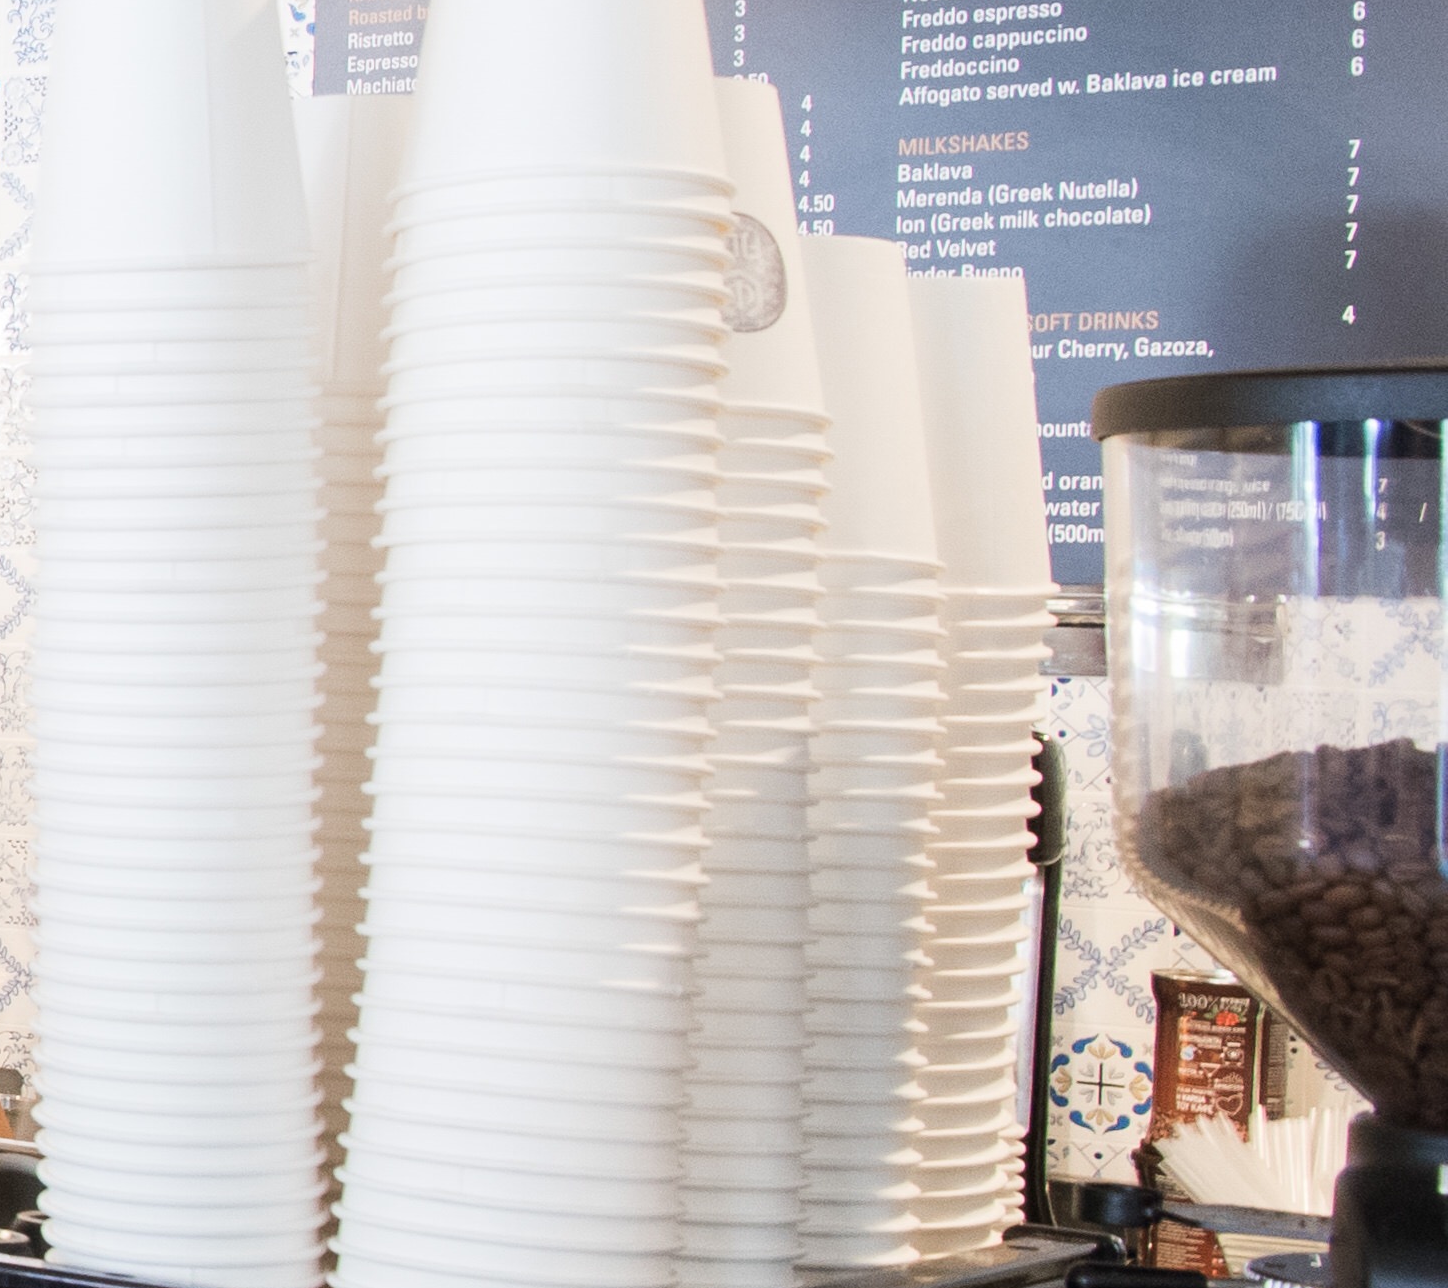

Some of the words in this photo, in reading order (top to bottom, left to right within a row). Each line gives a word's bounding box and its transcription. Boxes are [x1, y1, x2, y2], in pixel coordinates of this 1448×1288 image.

[348, 6, 412, 28] Roasted
[734, 0, 747, 17] 3
[902, 6, 969, 29] Freddo
[972, 1, 1063, 26] espresso
[1352, 0, 1366, 21] 6
[347, 30, 414, 50] Ristretto
[733, 24, 746, 42] 3
[901, 32, 968, 55] Freddo
[971, 23, 1088, 51] cappuccino
[1351, 28, 1365, 49] 6
[347, 53, 419, 75] Espresso
[732, 48, 745, 67] 3
[900, 55, 1020, 80] Freddoccino
[1350, 56, 1364, 77] 6
[899, 85, 981, 107] Affogato
[986, 77, 1053, 100] served
[1057, 78, 1080, 96] w.
[1085, 72, 1167, 94] Baklava
[1172, 67, 1204, 88] ice
[1209, 64, 1277, 86] cream
[801, 94, 813, 112] 4
[800, 119, 812, 137] 4
[799, 144, 811, 162] 4
[897, 131, 1030, 157] MILKSHAKES
[1348, 138, 1361, 159] 7
[798, 169, 810, 187] 4
[896, 164, 973, 183] Baklava
[1347, 166, 1360, 187] 7
[798, 194, 835, 213] 4.50
[896, 185, 983, 209] Merenda
[987, 181, 1054, 207] (Greek
[1058, 177, 1139, 201] Nutella)
[1346, 194, 1359, 214] 7
[796, 219, 834, 236] 4.50
[895, 214, 925, 234] Ion
[930, 210, 994, 234] (Greek
[999, 208, 1039, 230] milk
[1043, 203, 1152, 229] chocolate)
[1345, 222, 1358, 242] 7
[936, 237, 997, 259] Velvet
[1344, 249, 1357, 269] 7
[906, 265, 957, 279] inder
[1078, 309, 1160, 332] DRINKS
[1341, 304, 1356, 325] 4
[1030, 344, 1052, 359] ur
[1057, 338, 1130, 361] Cherry,
[1133, 336, 1215, 359] Gazoza,
[1045, 499, 1101, 517] water
